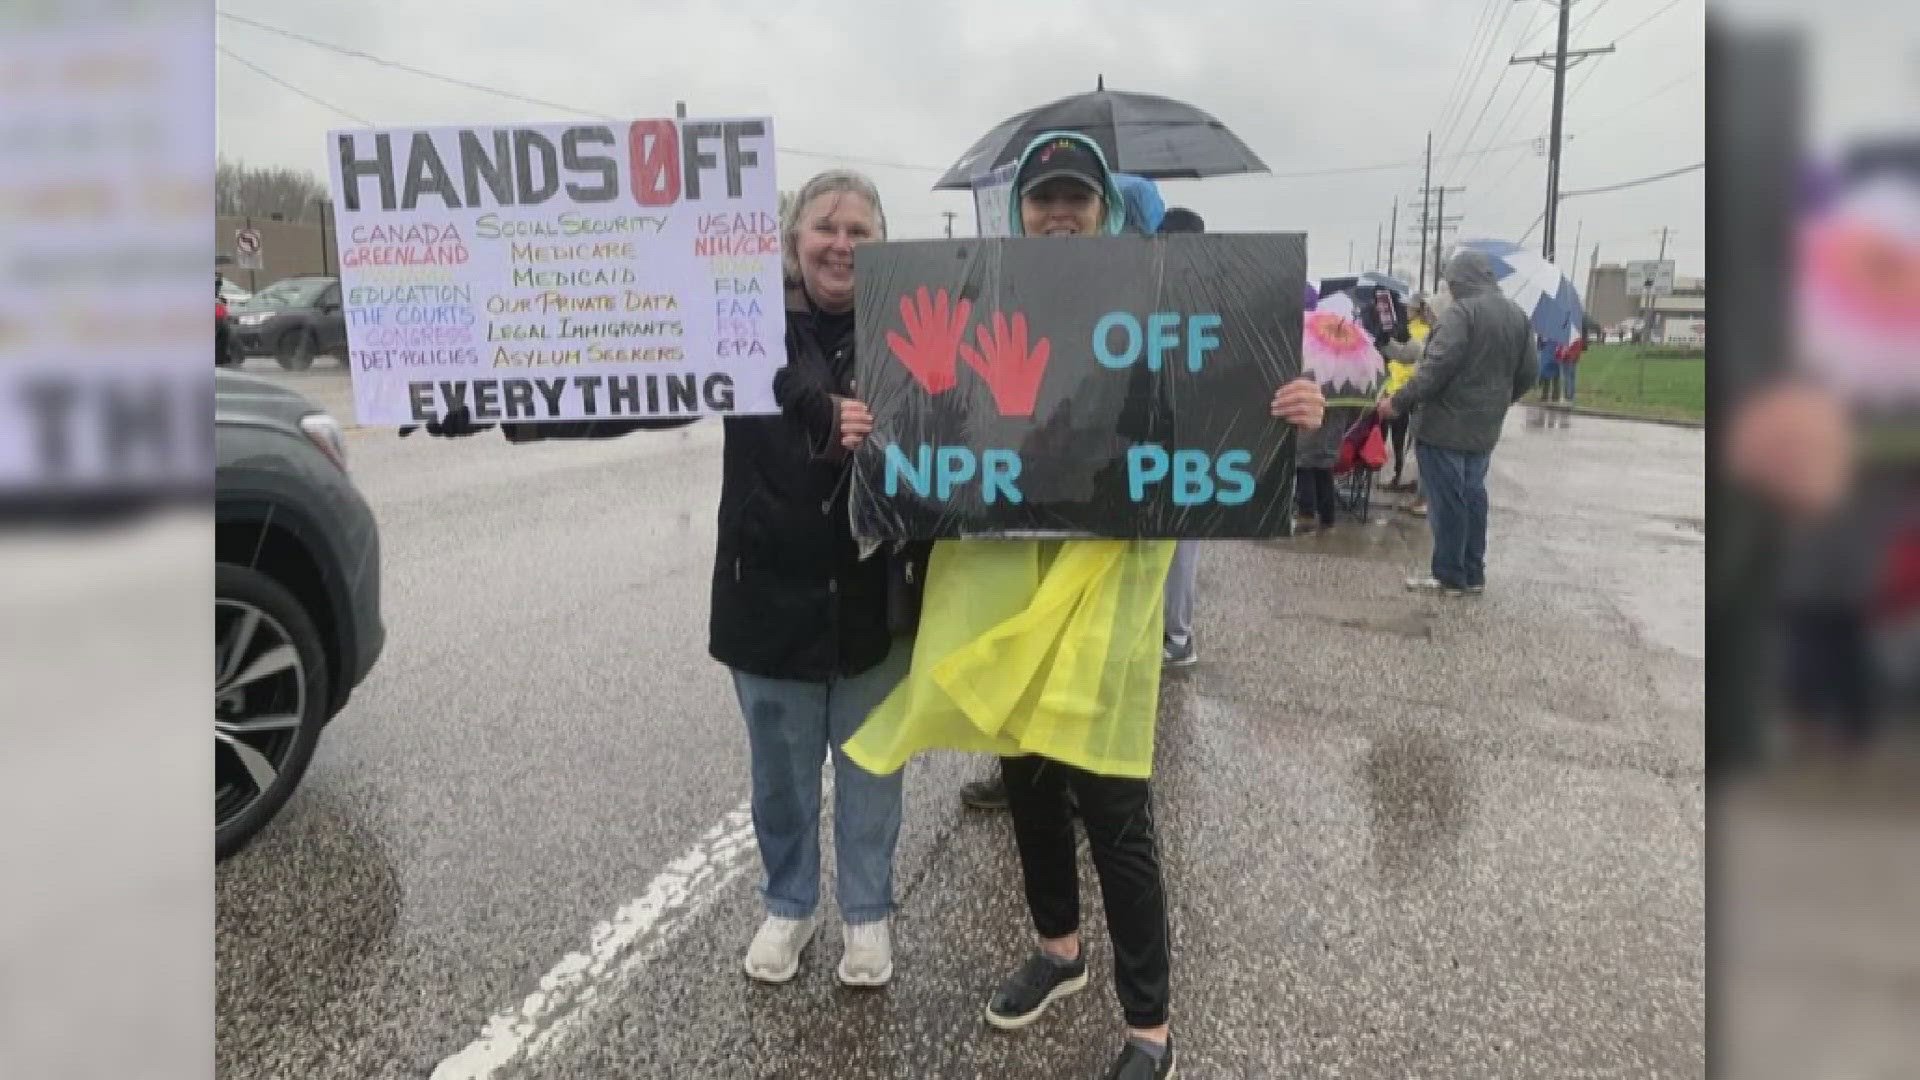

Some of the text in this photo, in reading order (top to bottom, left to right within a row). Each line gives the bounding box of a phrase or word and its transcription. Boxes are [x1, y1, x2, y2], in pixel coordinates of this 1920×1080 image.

[339, 125, 619, 211] HANDS
[351, 222, 462, 245] CANADA
[476, 211, 669, 239] SOCIAL SECURITY
[697, 212, 777, 235] USAID
[343, 244, 470, 267] GREENLAND
[510, 241, 638, 264] MEDICARE
[694, 236, 780, 257] NIH/CDC
[512, 267, 637, 288] MEDICAID
[715, 276, 763, 295] FDA
[349, 284, 471, 305] EDUCATION
[487, 289, 679, 315] OUR PRIVATE DATA
[395, 305, 475, 326] COURTS
[716, 298, 763, 317] FAA
[365, 326, 474, 346] CONGRESS
[487, 316, 684, 342] LEGAL IMMIGRANTS
[717, 339, 766, 358] EPA
[1092, 311, 1223, 372] OFF
[398, 346, 479, 366] POLICIES
[493, 343, 685, 369] ASYLUM SEEKERS
[407, 372, 736, 421] EVERYTHING
[884, 441, 1256, 506] NPR PBS
